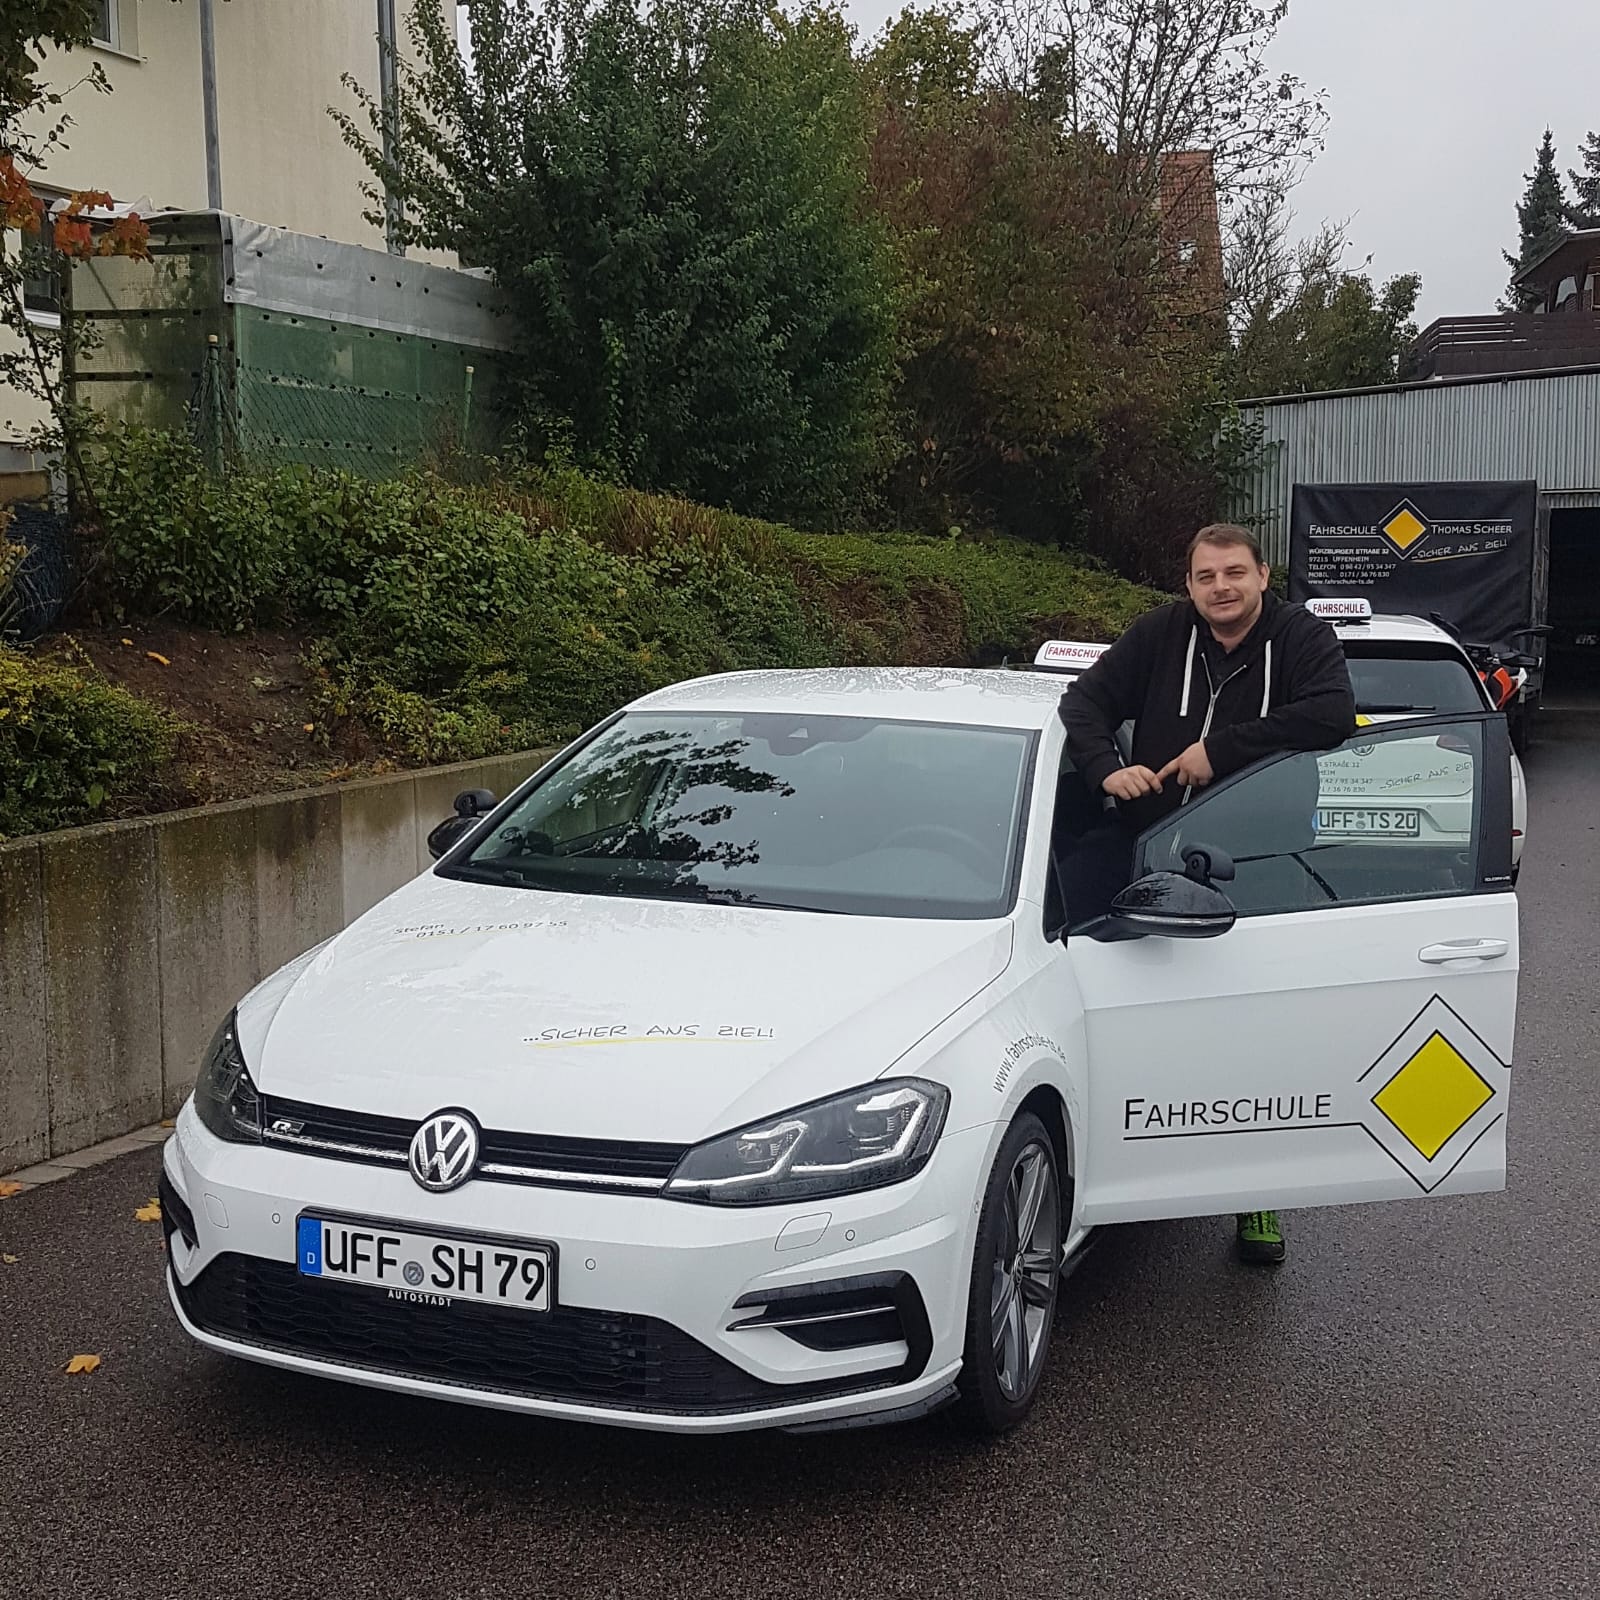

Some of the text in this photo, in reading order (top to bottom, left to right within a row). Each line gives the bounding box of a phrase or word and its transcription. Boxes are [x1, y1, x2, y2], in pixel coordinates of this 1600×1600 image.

[1309, 523, 1513, 535] FAHRSCHULE THOMAS SCHEER
[1313, 603, 1365, 614] FAHRSCHULE
[1047, 646, 1102, 659] FAHRSCHUL
[1319, 811, 1416, 829] UFF TS 20
[393, 923, 445, 935] Stefan
[416, 927, 454, 938] 0151
[646, 1023, 701, 1038] ANS
[717, 1024, 775, 1039] ZIEL!
[1123, 1094, 1332, 1131] FAHRSCHULE
[306, 1251, 316, 1265] D
[324, 1228, 545, 1302] UFF SH 79
[387, 1289, 453, 1307] AUTOSTADT
